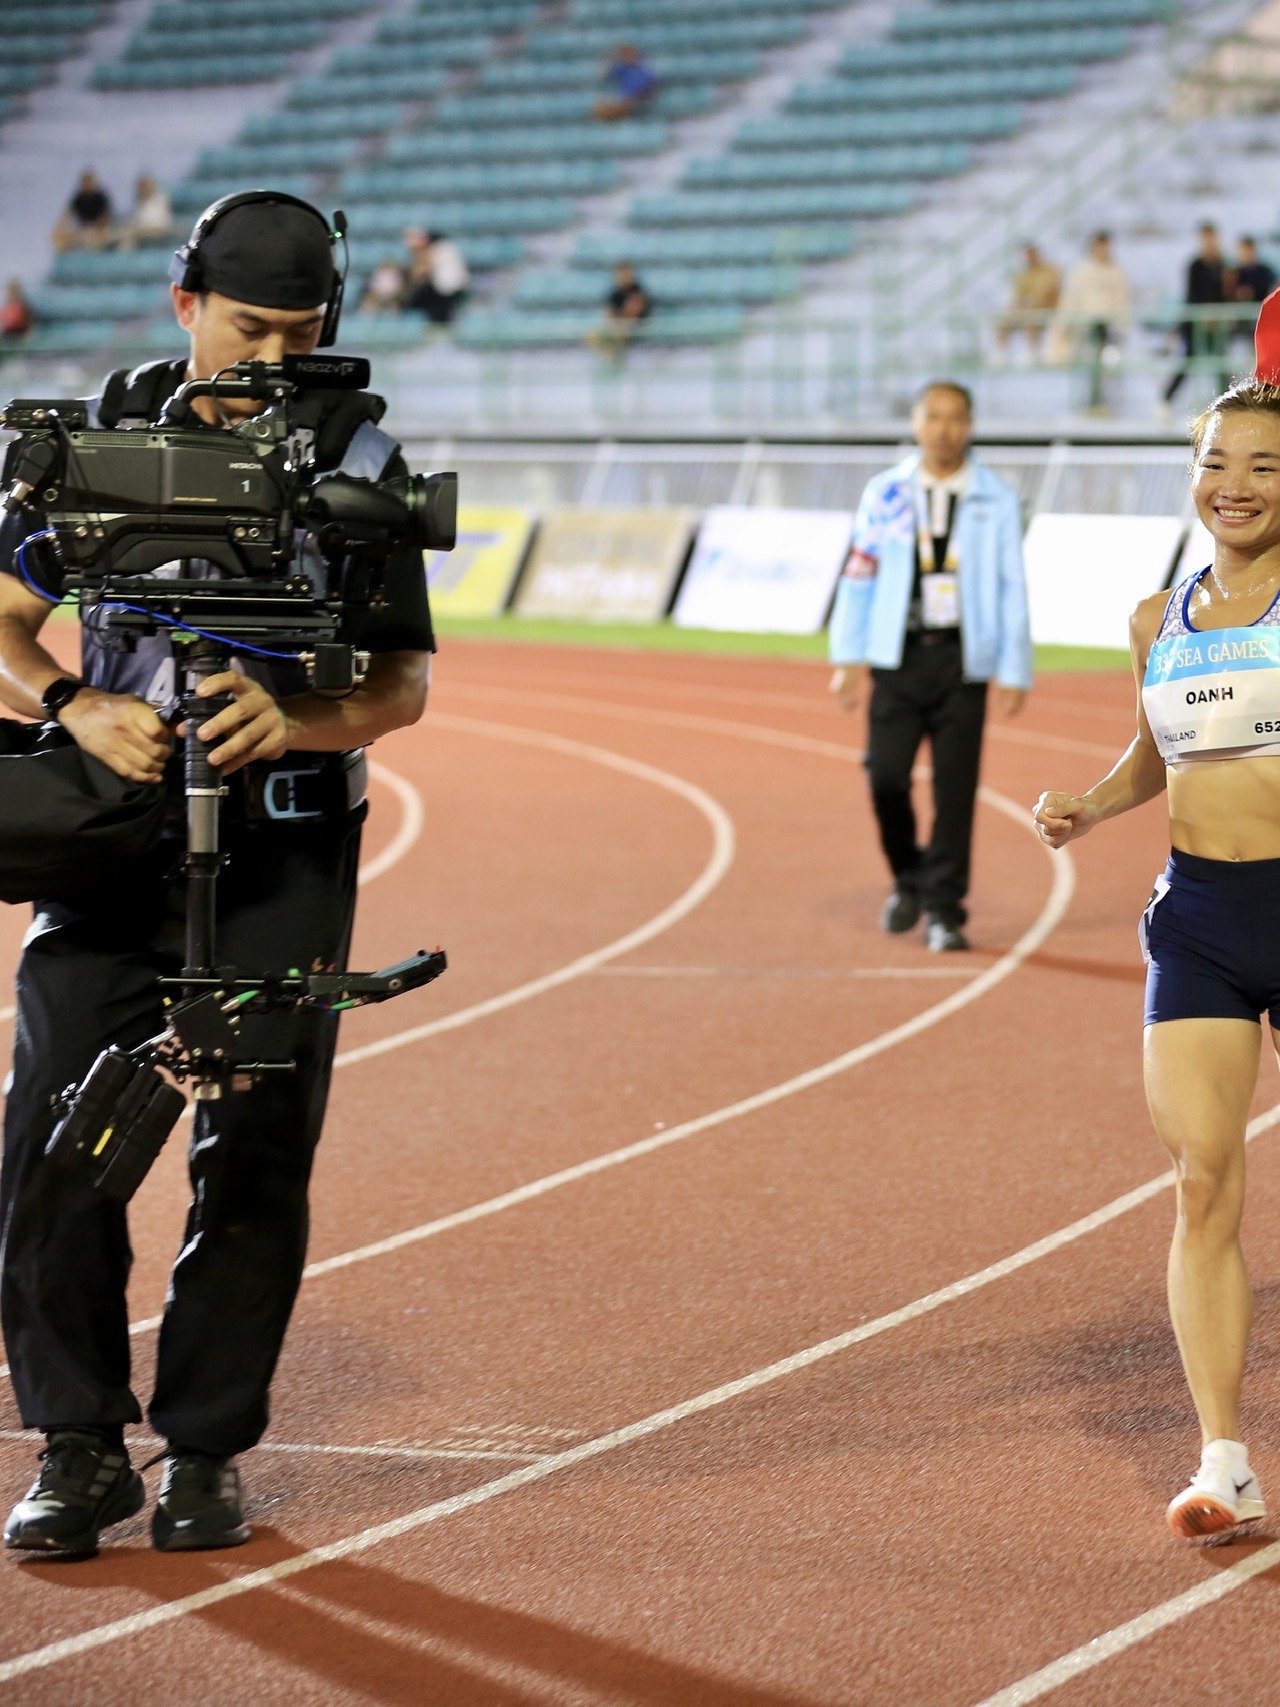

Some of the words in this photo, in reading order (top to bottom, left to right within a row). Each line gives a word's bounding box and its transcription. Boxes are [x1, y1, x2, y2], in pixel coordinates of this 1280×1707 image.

[229, 462, 264, 470] HITACHI
[241, 479, 250, 493] 1
[1154, 648, 1176, 674] 33
[1176, 646, 1204, 668] SEA
[1207, 639, 1270, 663] GAMES
[1186, 686, 1234, 705] OANH
